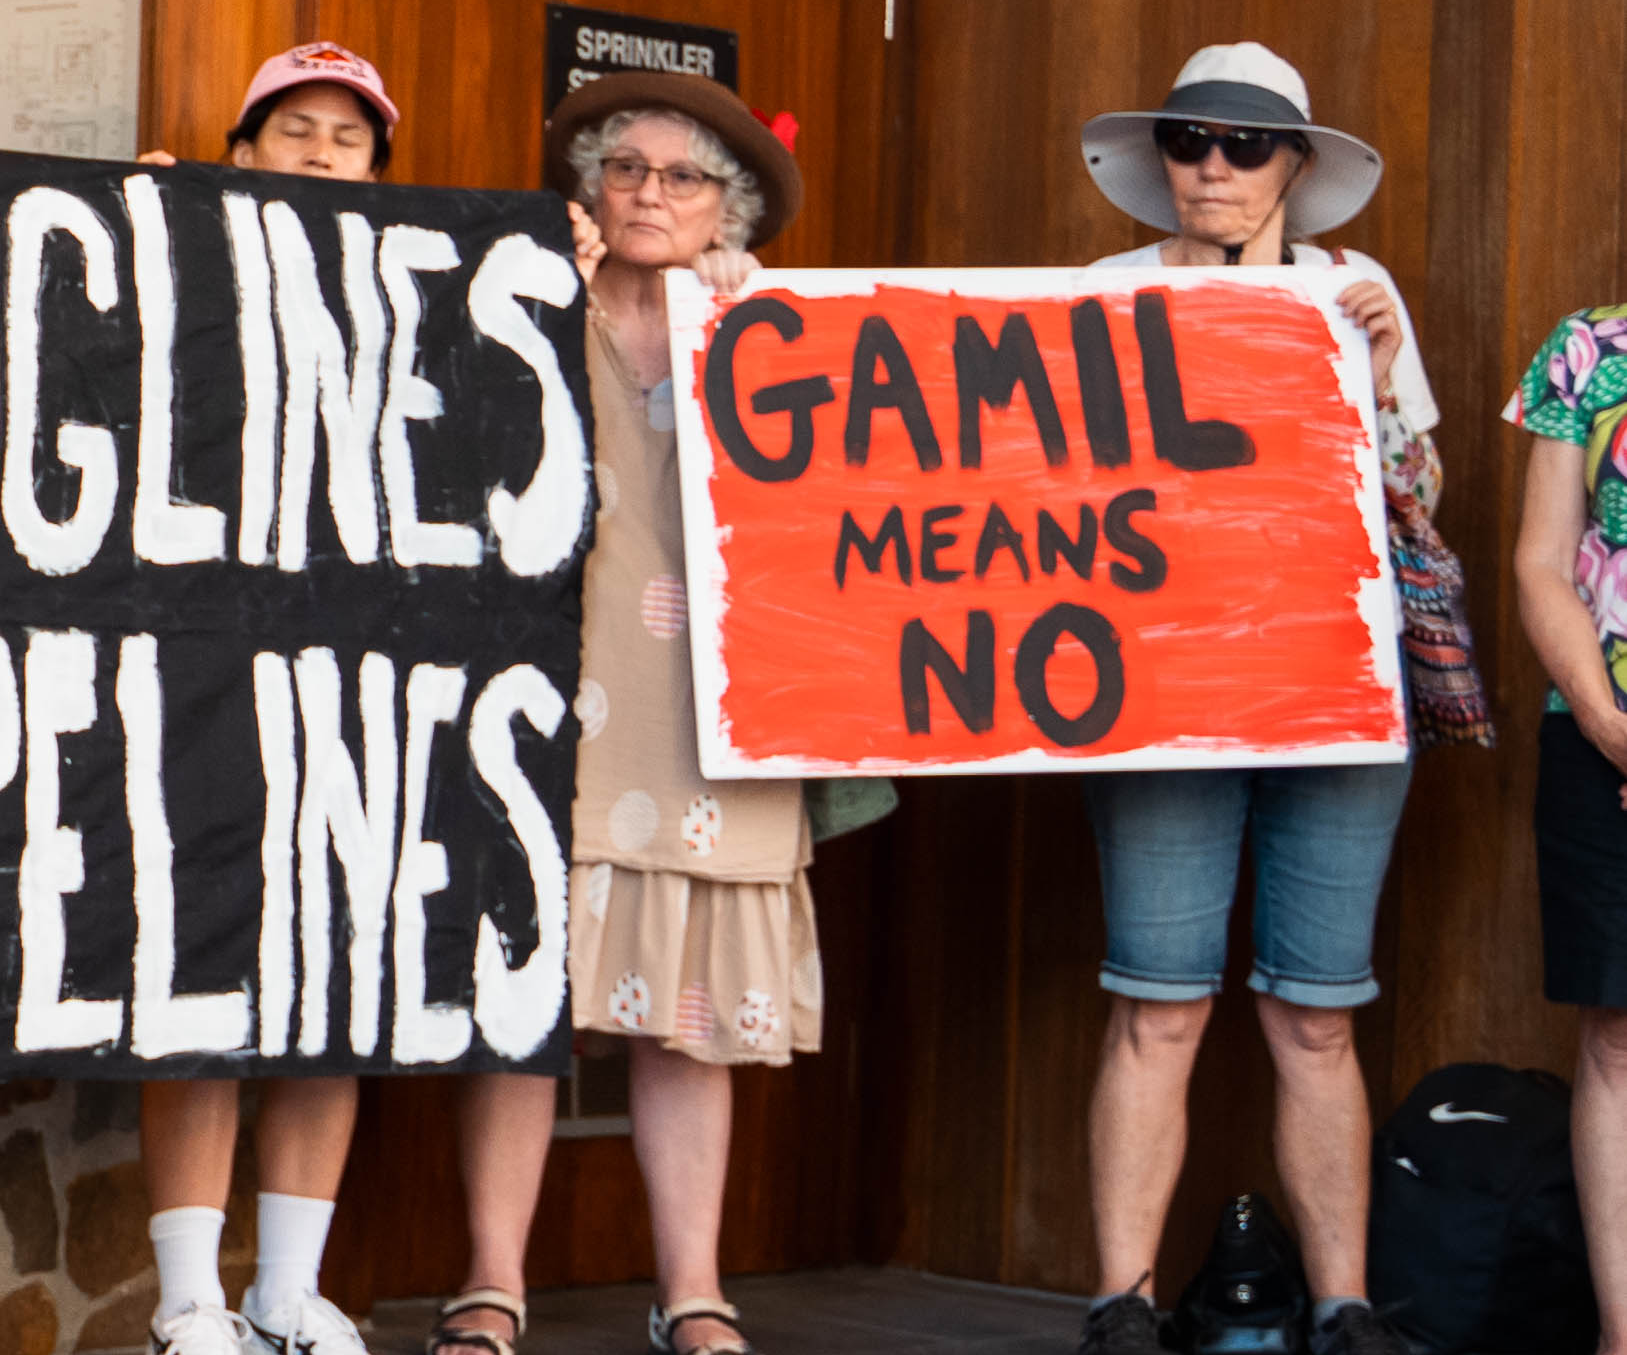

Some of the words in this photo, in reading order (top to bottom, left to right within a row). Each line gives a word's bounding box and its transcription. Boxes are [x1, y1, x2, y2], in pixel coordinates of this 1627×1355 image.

[576, 25, 715, 78] SPRINKLER
[704, 292, 1256, 483] GAMIL
[834, 487, 1168, 593] MEANS
[900, 602, 1124, 747] NO
